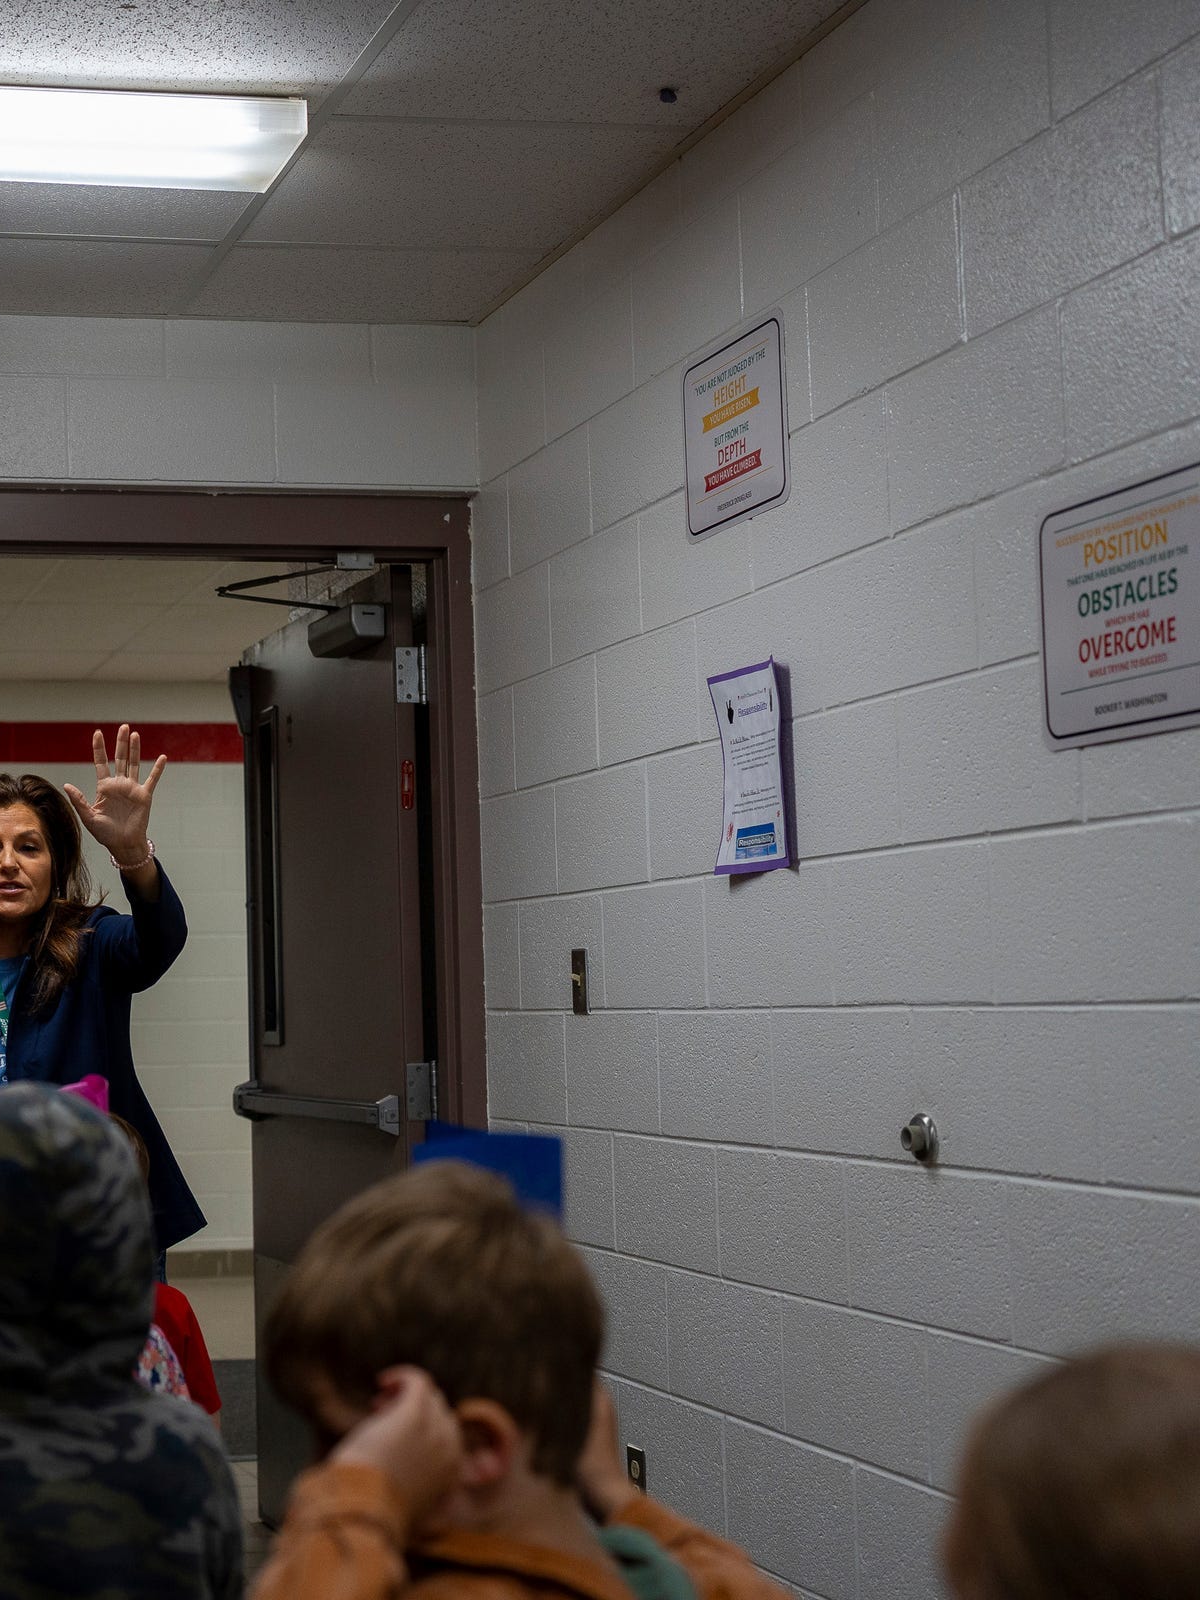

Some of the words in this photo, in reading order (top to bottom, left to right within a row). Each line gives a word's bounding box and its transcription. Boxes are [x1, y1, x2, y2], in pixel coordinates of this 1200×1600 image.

[707, 376, 717, 389] ARE
[717, 370, 727, 383] NOT
[727, 359, 748, 379] JUDGED
[748, 355, 755, 367] BY
[755, 348, 766, 362] THE
[713, 374, 747, 407] HEIGHT
[720, 404, 735, 420] HAVE
[714, 434, 724, 447] BUT
[724, 428, 738, 442] FROM
[739, 420, 750, 434] THE
[717, 437, 746, 466] DEPTH
[708, 473, 720, 487] YOU
[720, 467, 734, 482] HAVE
[1083, 520, 1169, 568] POSITION
[1077, 567, 1179, 618] OBSTACLES
[1078, 616, 1177, 664] OVERCOME
[1124, 693, 1169, 711] WASHINGTON
